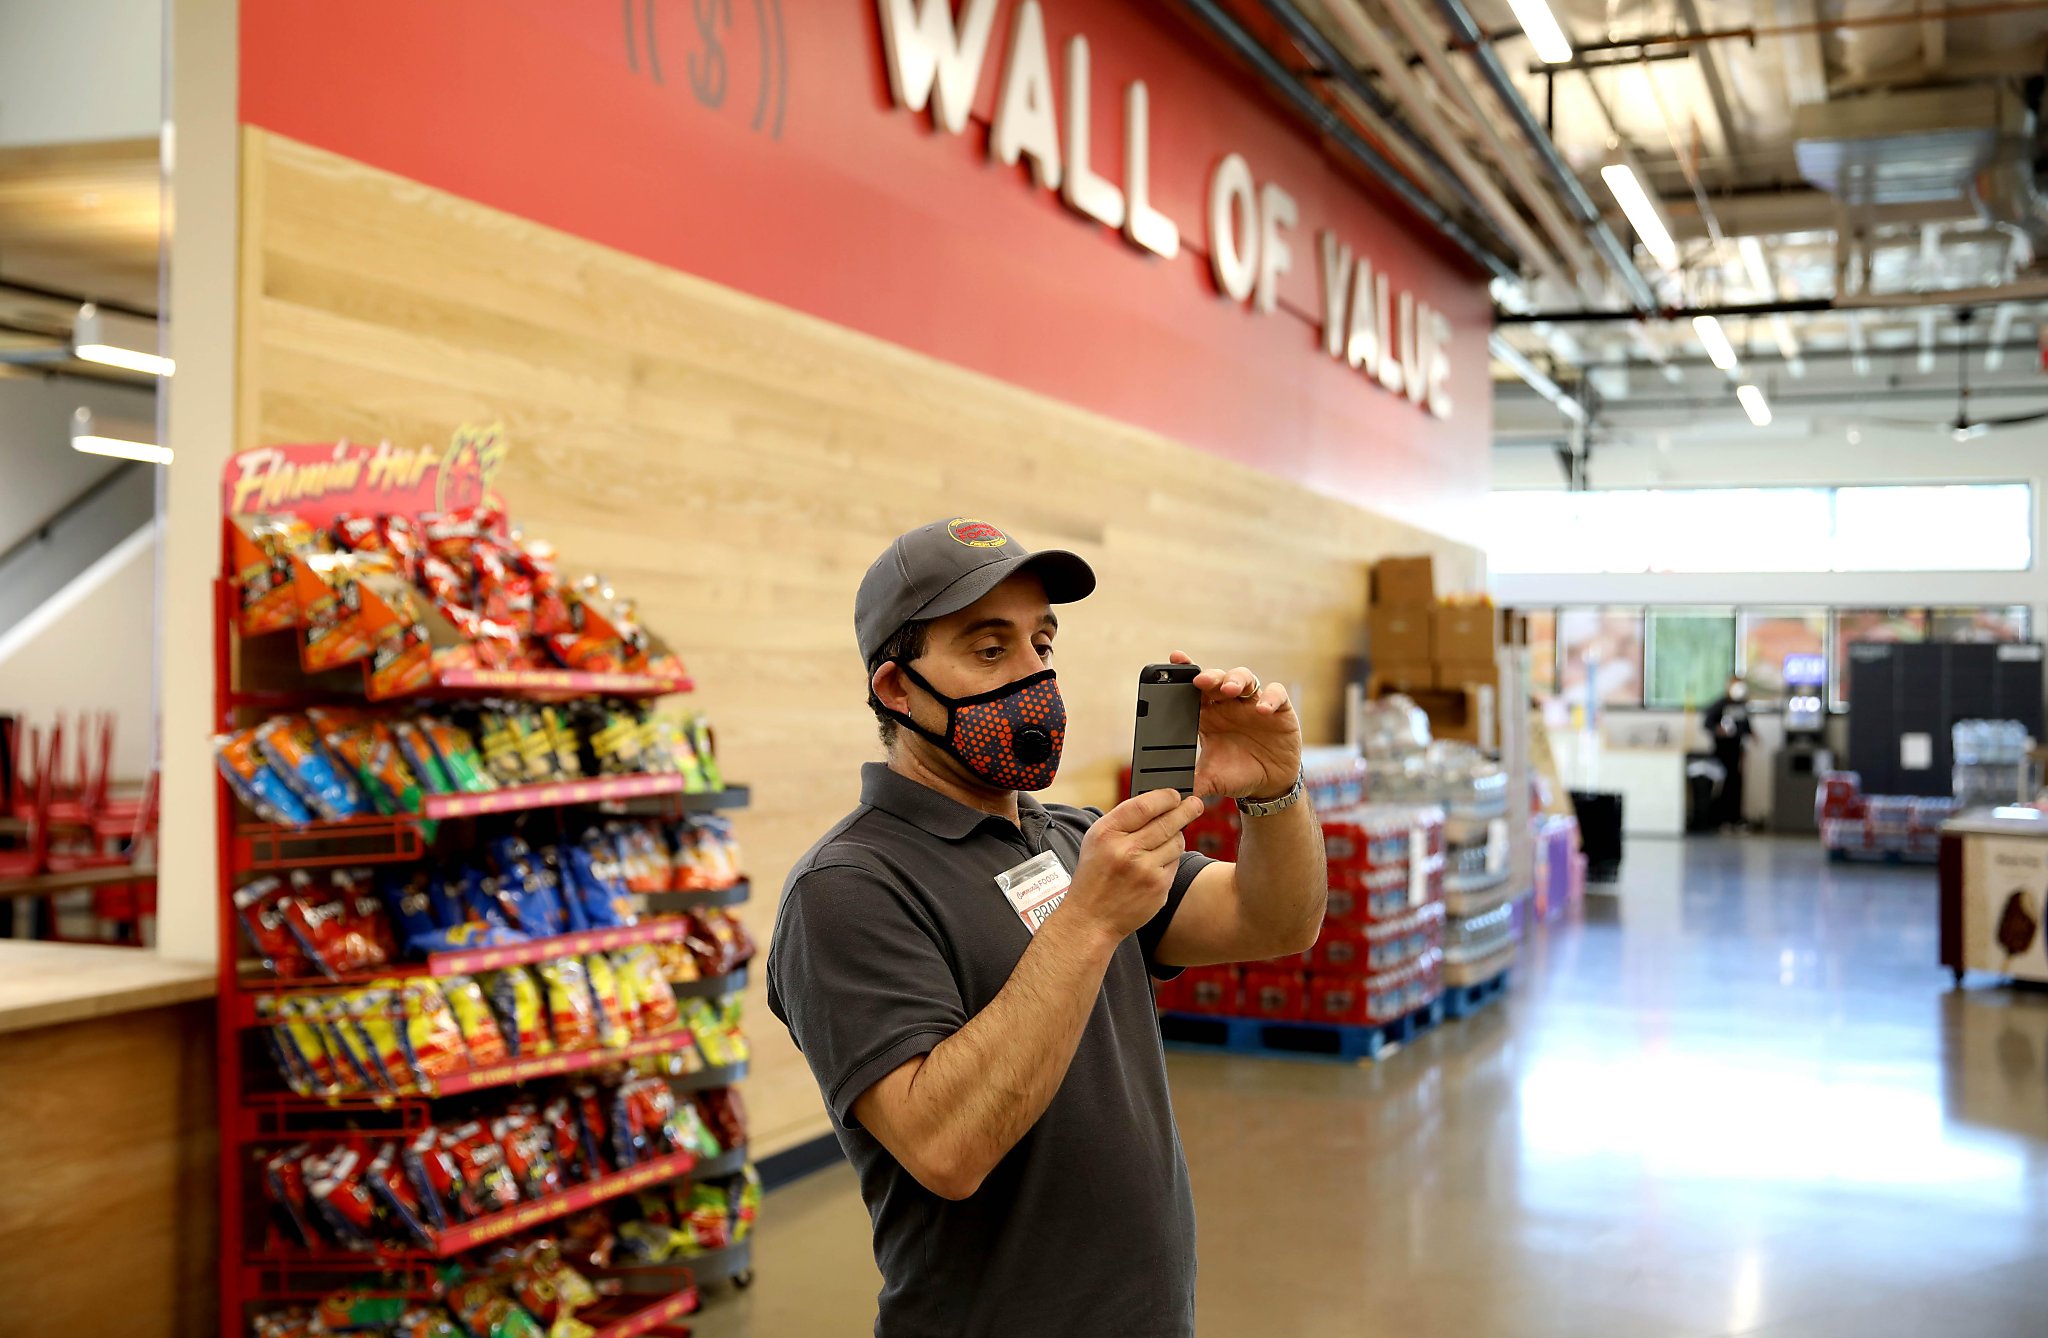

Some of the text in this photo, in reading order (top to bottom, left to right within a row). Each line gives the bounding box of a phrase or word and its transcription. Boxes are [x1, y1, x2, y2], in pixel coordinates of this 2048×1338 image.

[880, 0, 1452, 420] WALL OF VALUE
